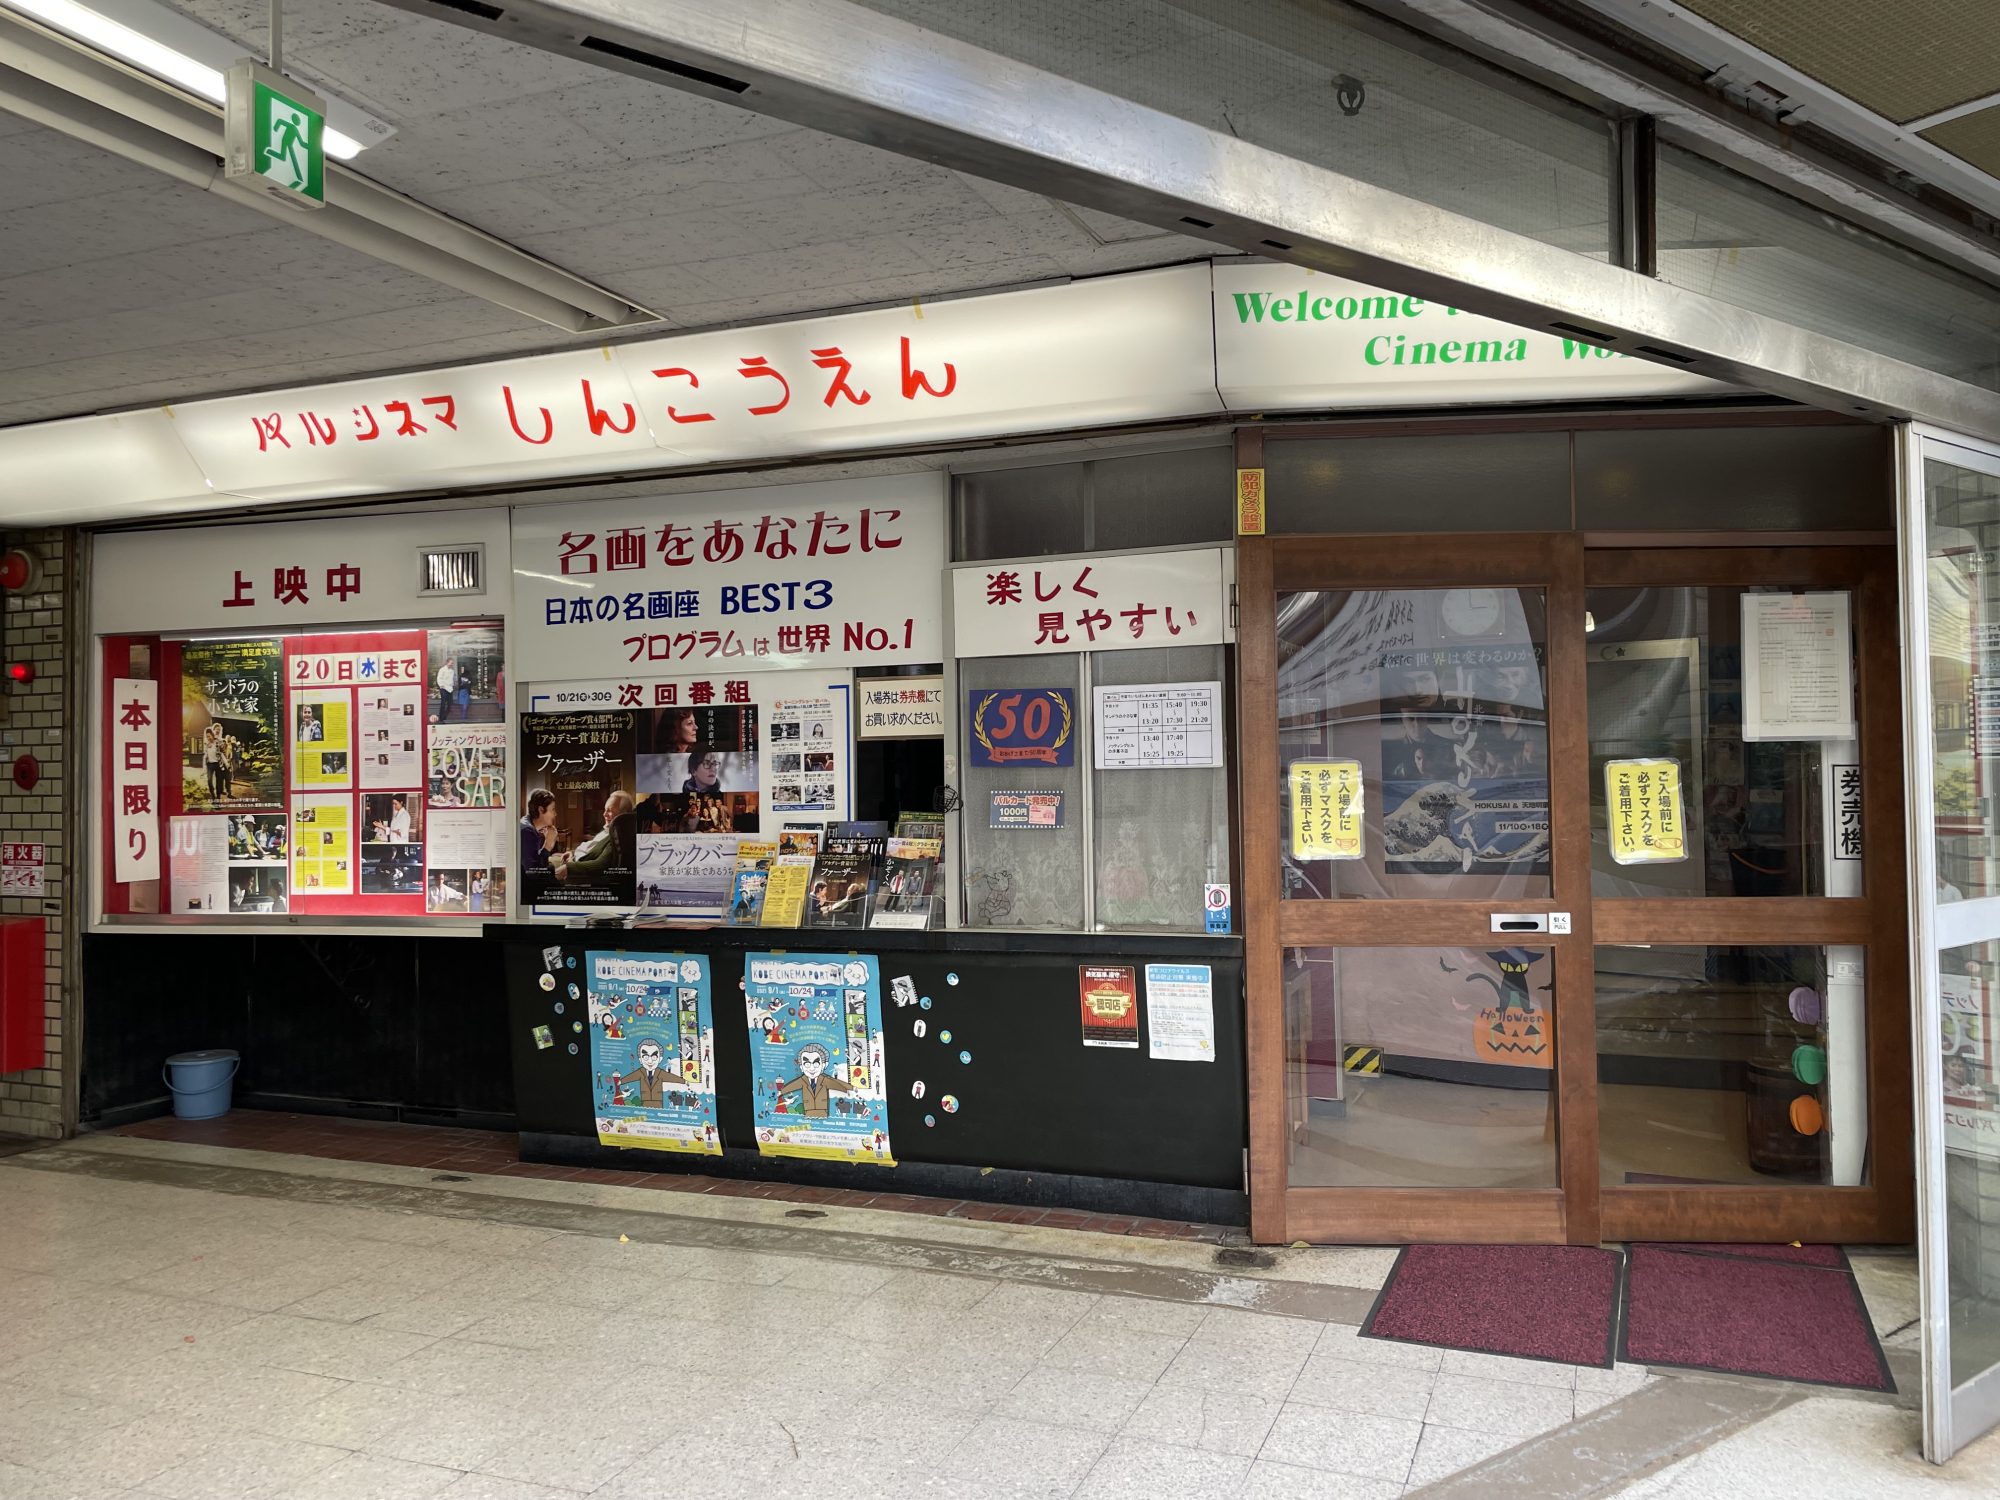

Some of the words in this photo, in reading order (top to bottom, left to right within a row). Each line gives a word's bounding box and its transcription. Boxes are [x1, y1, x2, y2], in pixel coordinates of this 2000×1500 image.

[1235, 291, 1424, 324] Welcome
[1364, 335, 1528, 366] Cinema
[251, 393, 459, 453] パルシネマ
[501, 335, 958, 446] しんこうえん
[557, 508, 904, 576] 名画をあなたに
[222, 562, 362, 608] 上映中
[545, 589, 701, 626] 日本の名画座
[720, 578, 834, 615] BEST3
[985, 565, 1100, 607] 楽しく
[843, 618, 915, 653] No.1
[1034, 601, 1198, 646] 見やすい
[205, 680, 259, 694] サンドラの
[618, 681, 752, 707] 次回番組
[865, 689, 942, 705] 入場券は券売機にて
[208, 697, 259, 713] 小さな家
[865, 711, 943, 727] お買い求めください。
[990, 694, 1051, 740] 50
[536, 748, 622, 774] ファーザー
[119, 698, 153, 862] 本日限り
[999, 808, 1027, 816] 1000円
[1300, 770, 1314, 849] ご着用下さい。
[1318, 769, 1332, 844] 必ずマスクを
[1619, 773, 1635, 853] ご着用下さい。
[1638, 771, 1654, 847] 必ずマスクを
[1658, 771, 1673, 833] ご入場前に
[4, 845, 43, 860] 消火器
[618, 967, 646, 976] CINEMA
[776, 970, 807, 979] CINEMA
[789, 986, 813, 995] 10/24
[1096, 998, 1121, 1011] 認可店
